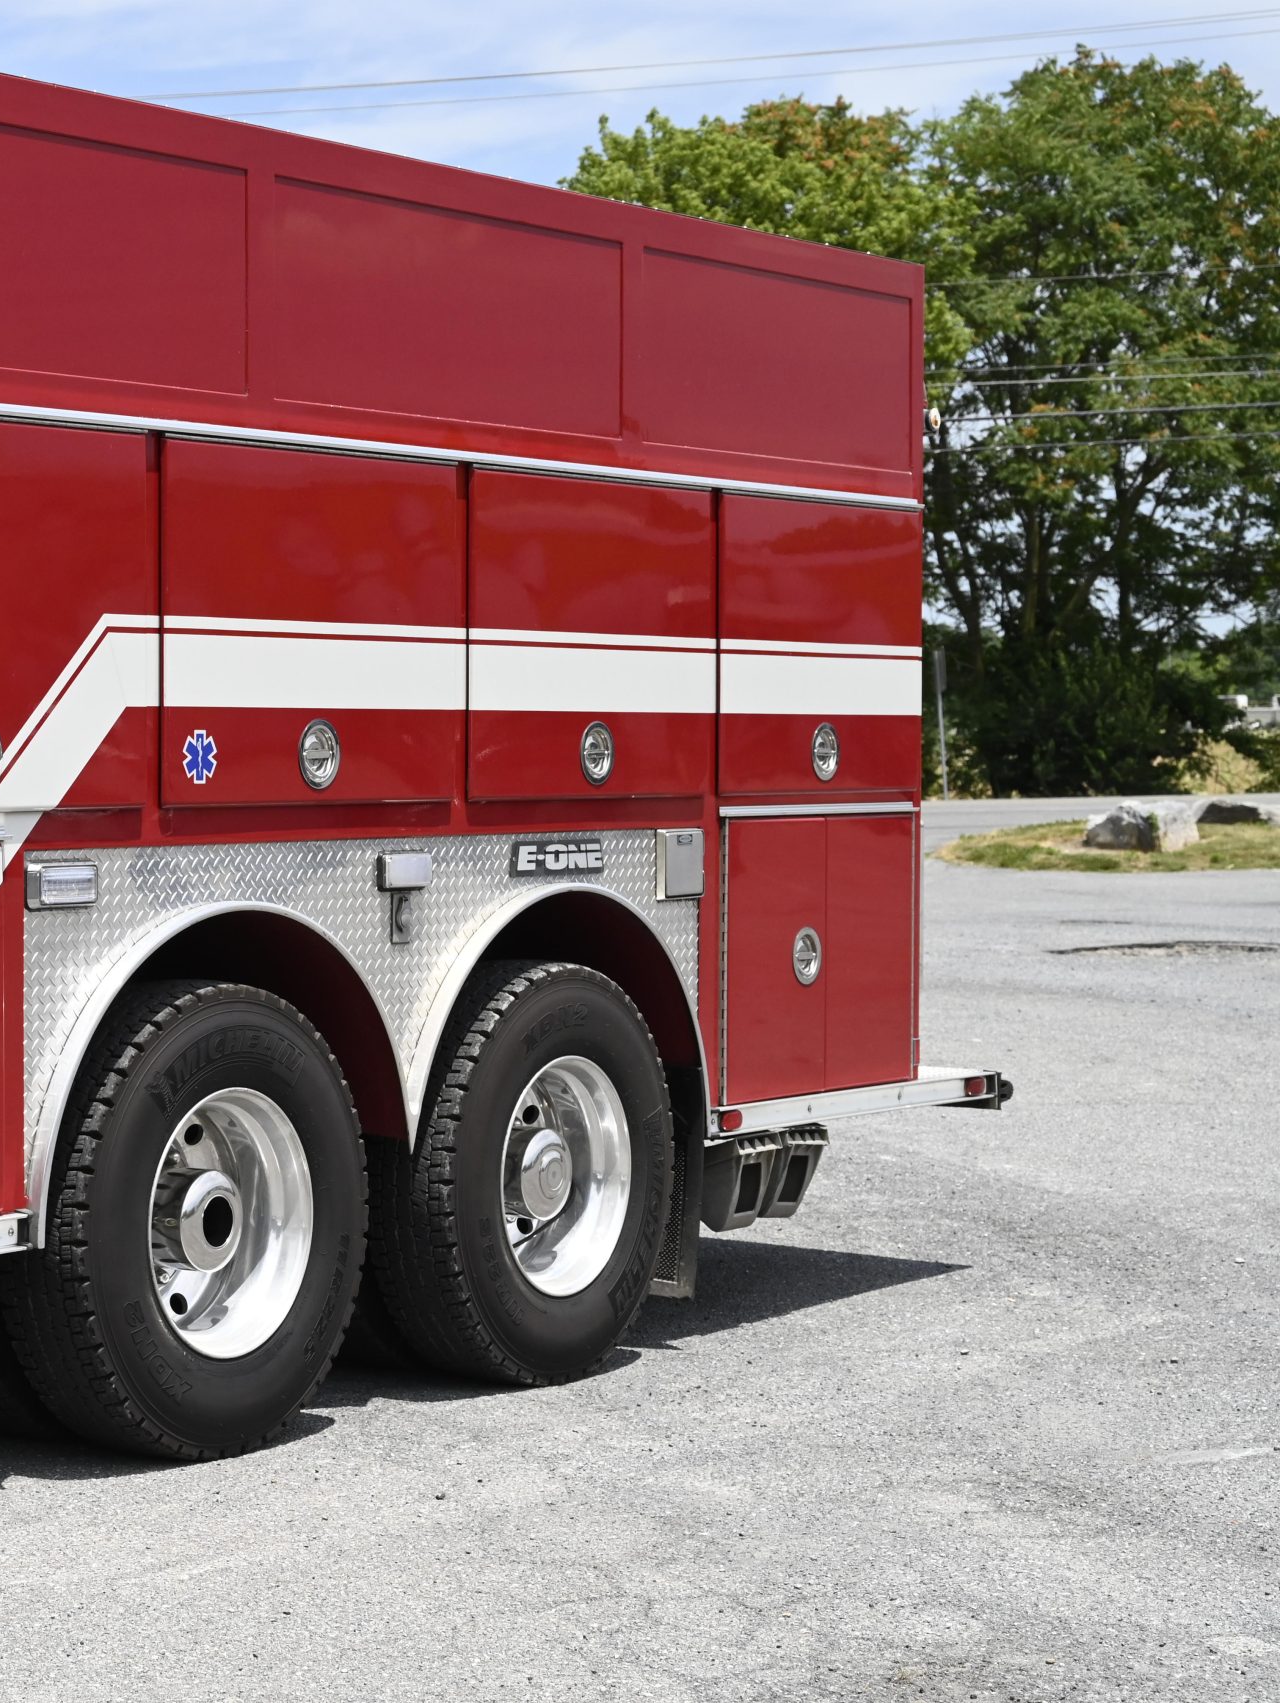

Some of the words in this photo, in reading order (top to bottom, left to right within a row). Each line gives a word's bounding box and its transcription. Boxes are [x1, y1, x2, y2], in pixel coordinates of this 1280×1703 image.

[517, 843, 603, 871] E-ONE
[173, 1029, 306, 1088] MICHELIN
[121, 1299, 193, 1407] XDN2
